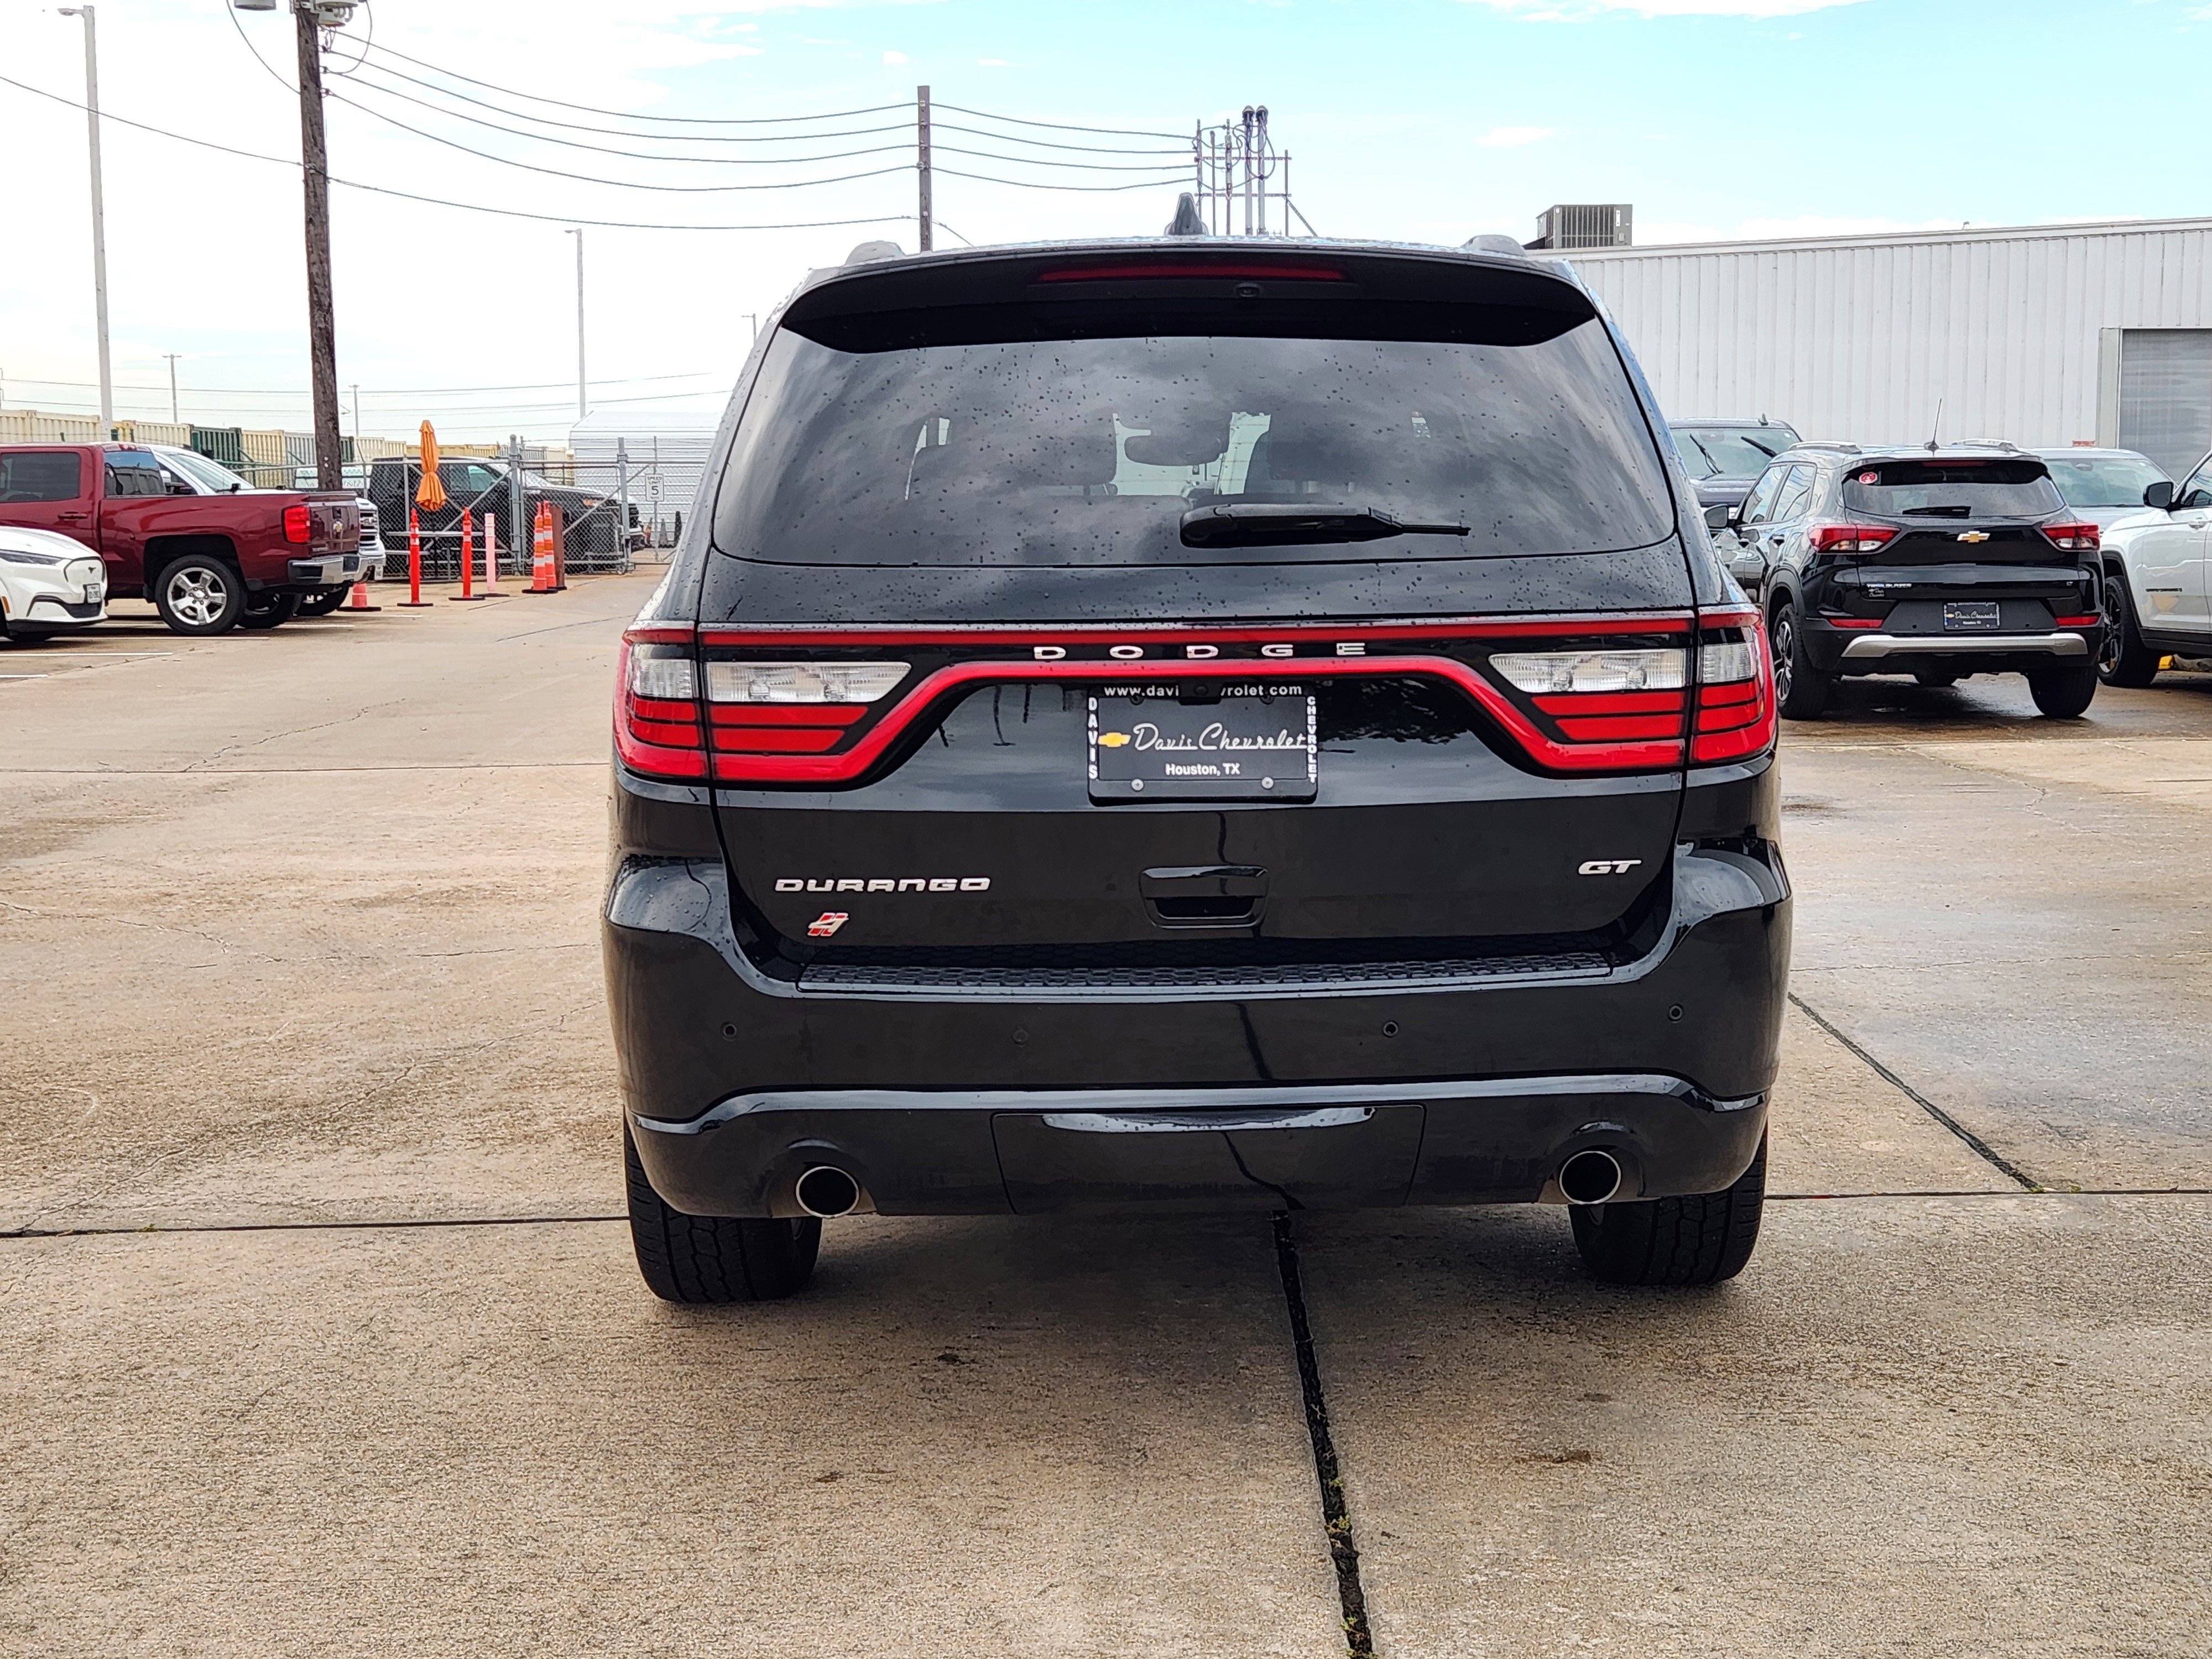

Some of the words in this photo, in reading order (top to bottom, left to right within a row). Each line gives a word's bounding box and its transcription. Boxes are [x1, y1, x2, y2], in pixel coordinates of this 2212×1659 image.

[651, 485, 659, 495] 5
[1033, 642, 1366, 660] DODGE
[1088, 697, 1098, 780] DAVIS
[1133, 723, 1198, 751] Davis
[1198, 722, 1307, 750] Chevrolet
[1307, 696, 1317, 784] CHEVROLET
[1165, 763, 1221, 777] Houston,
[1222, 762, 1241, 775] TX
[1578, 859, 1642, 875] GT
[775, 877, 991, 892] DURANGO
